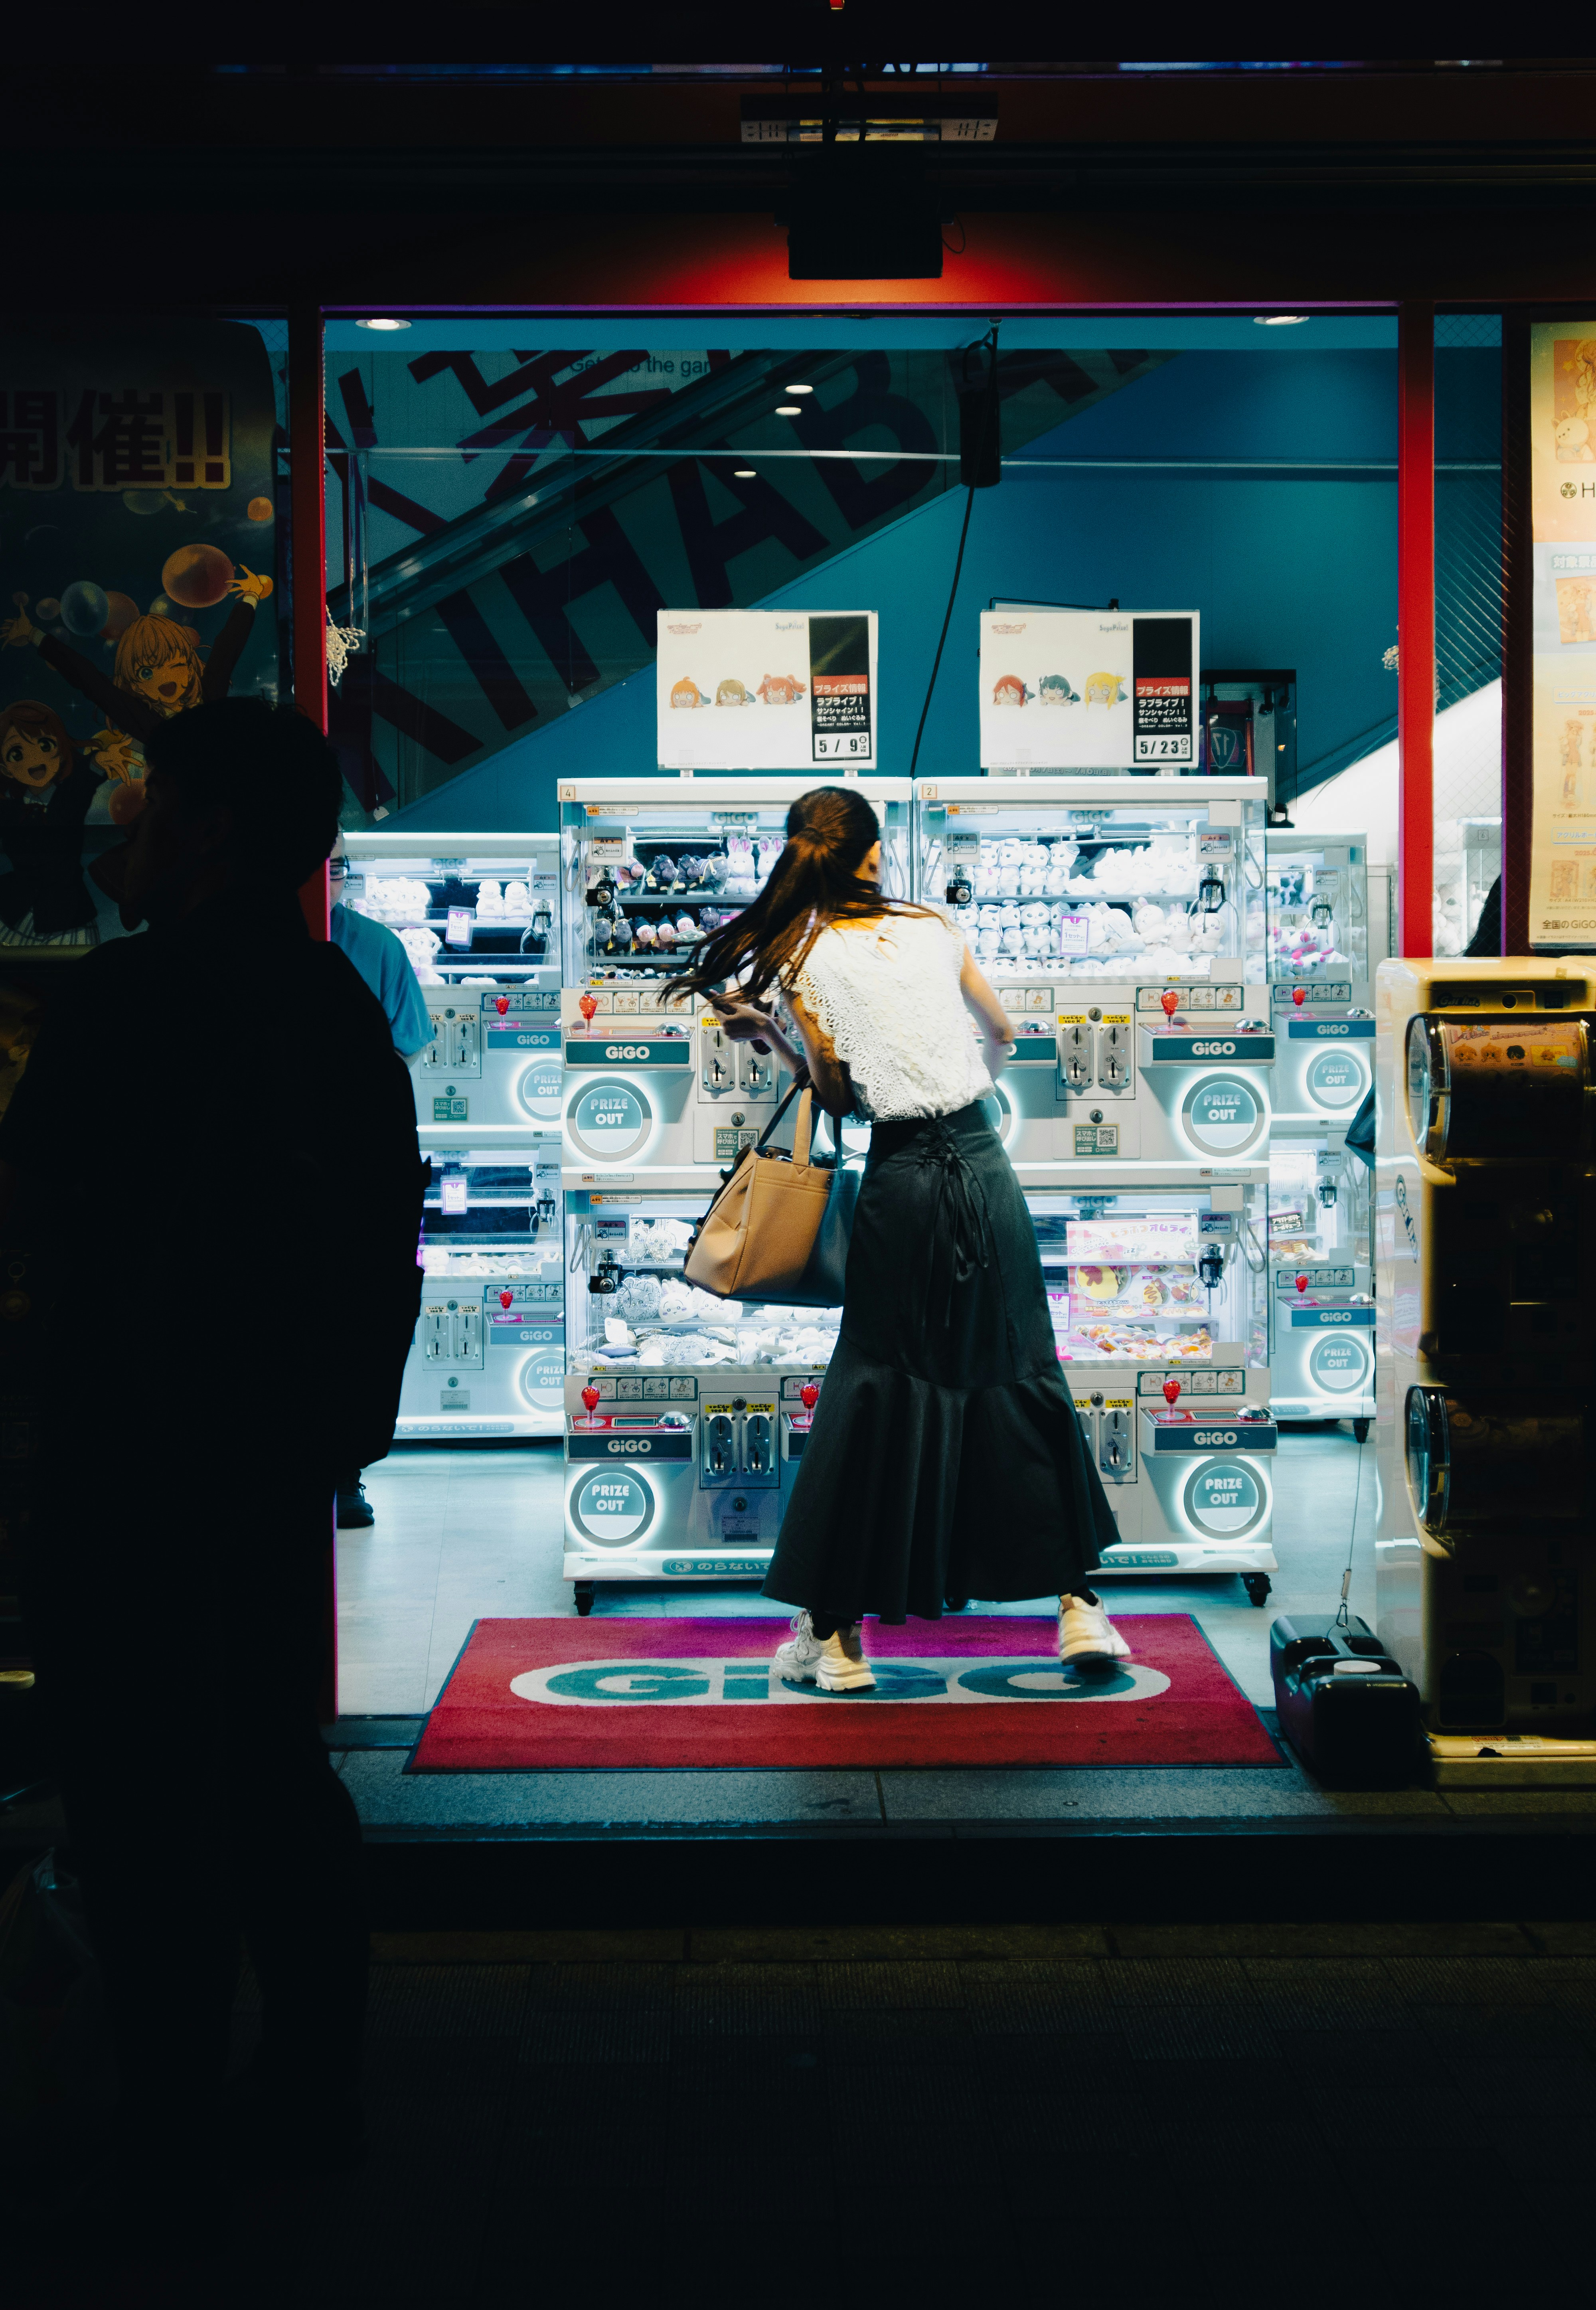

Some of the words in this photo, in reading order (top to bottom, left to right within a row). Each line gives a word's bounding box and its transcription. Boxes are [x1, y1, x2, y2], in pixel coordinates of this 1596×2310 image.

[647, 356, 674, 372] the
[815, 684, 866, 694] プライズ情報
[1137, 686, 1189, 695] プライズ情報
[714, 812, 757, 824] GiGO
[1072, 810, 1114, 824] GiGO
[1317, 1024, 1349, 1035] GiGO
[517, 1035, 549, 1045] GiGO
[605, 1045, 650, 1059] GiGO
[1191, 1041, 1236, 1055] GiGO
[1322, 1064, 1349, 1073] PRIZE
[1325, 1075, 1346, 1085] OUT
[537, 1086, 559, 1095] OUT
[591, 1098, 628, 1110] PRIZE
[1203, 1094, 1241, 1106] PRIZE
[595, 1113, 624, 1125] OUT
[1208, 1109, 1237, 1121] OUT
[1319, 1312, 1352, 1322] GiGO
[520, 1331, 552, 1341] GiGO
[1324, 1348, 1351, 1358] PRIZE
[1328, 1359, 1349, 1368] OUT
[540, 1377, 561, 1385] OUT
[1194, 1431, 1237, 1445] GiGO
[607, 1439, 652, 1453] GiGO
[1205, 1478, 1242, 1490] PRIZE
[592, 1484, 630, 1497] PRIZE
[1210, 1493, 1238, 1505] OUT
[596, 1500, 624, 1512] OUT
